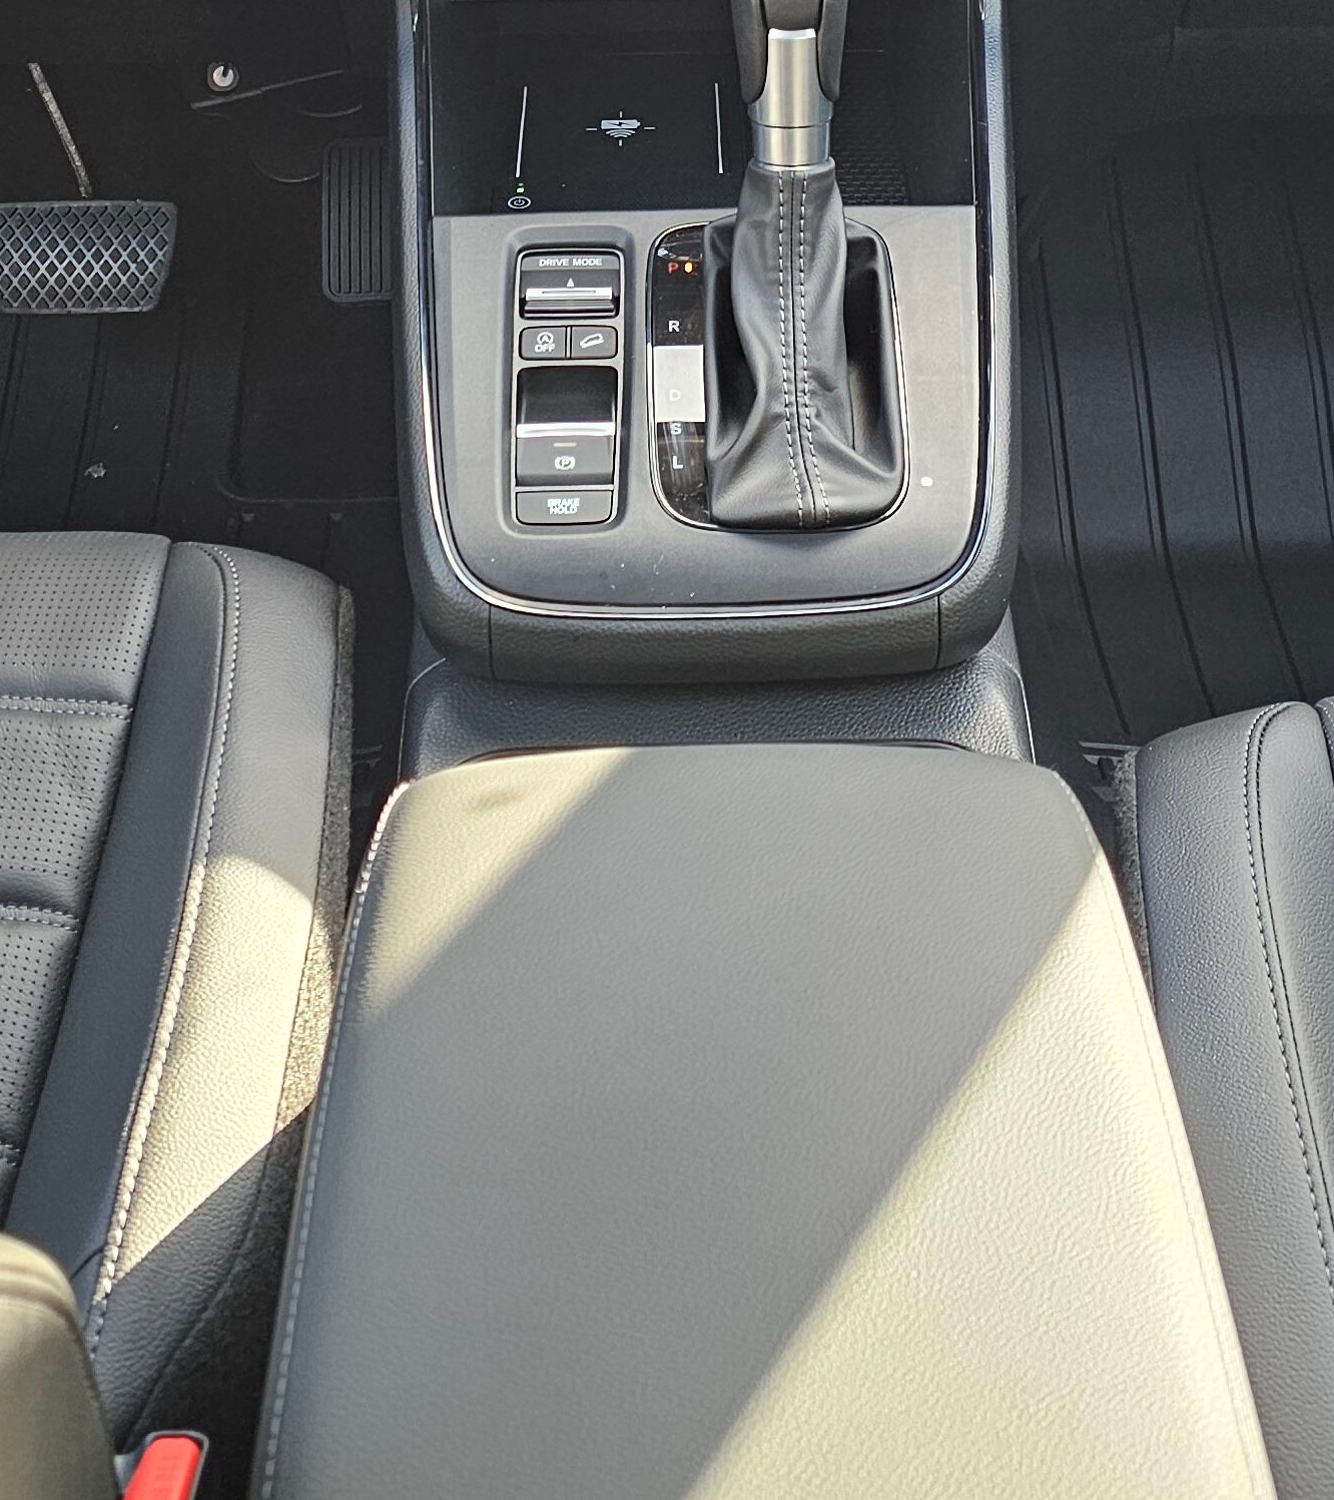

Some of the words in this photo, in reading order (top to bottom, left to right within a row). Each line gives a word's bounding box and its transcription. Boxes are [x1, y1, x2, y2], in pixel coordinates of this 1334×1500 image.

[538, 257, 569, 268] DRIVE
[572, 256, 603, 267] MODE
[668, 262, 679, 274] P
[668, 319, 681, 332] R
[534, 343, 556, 353] OFF
[669, 389, 681, 401] D
[670, 423, 682, 435] S
[672, 456, 684, 469] L
[547, 497, 580, 508] BRAKE
[549, 506, 578, 516] HOLD
